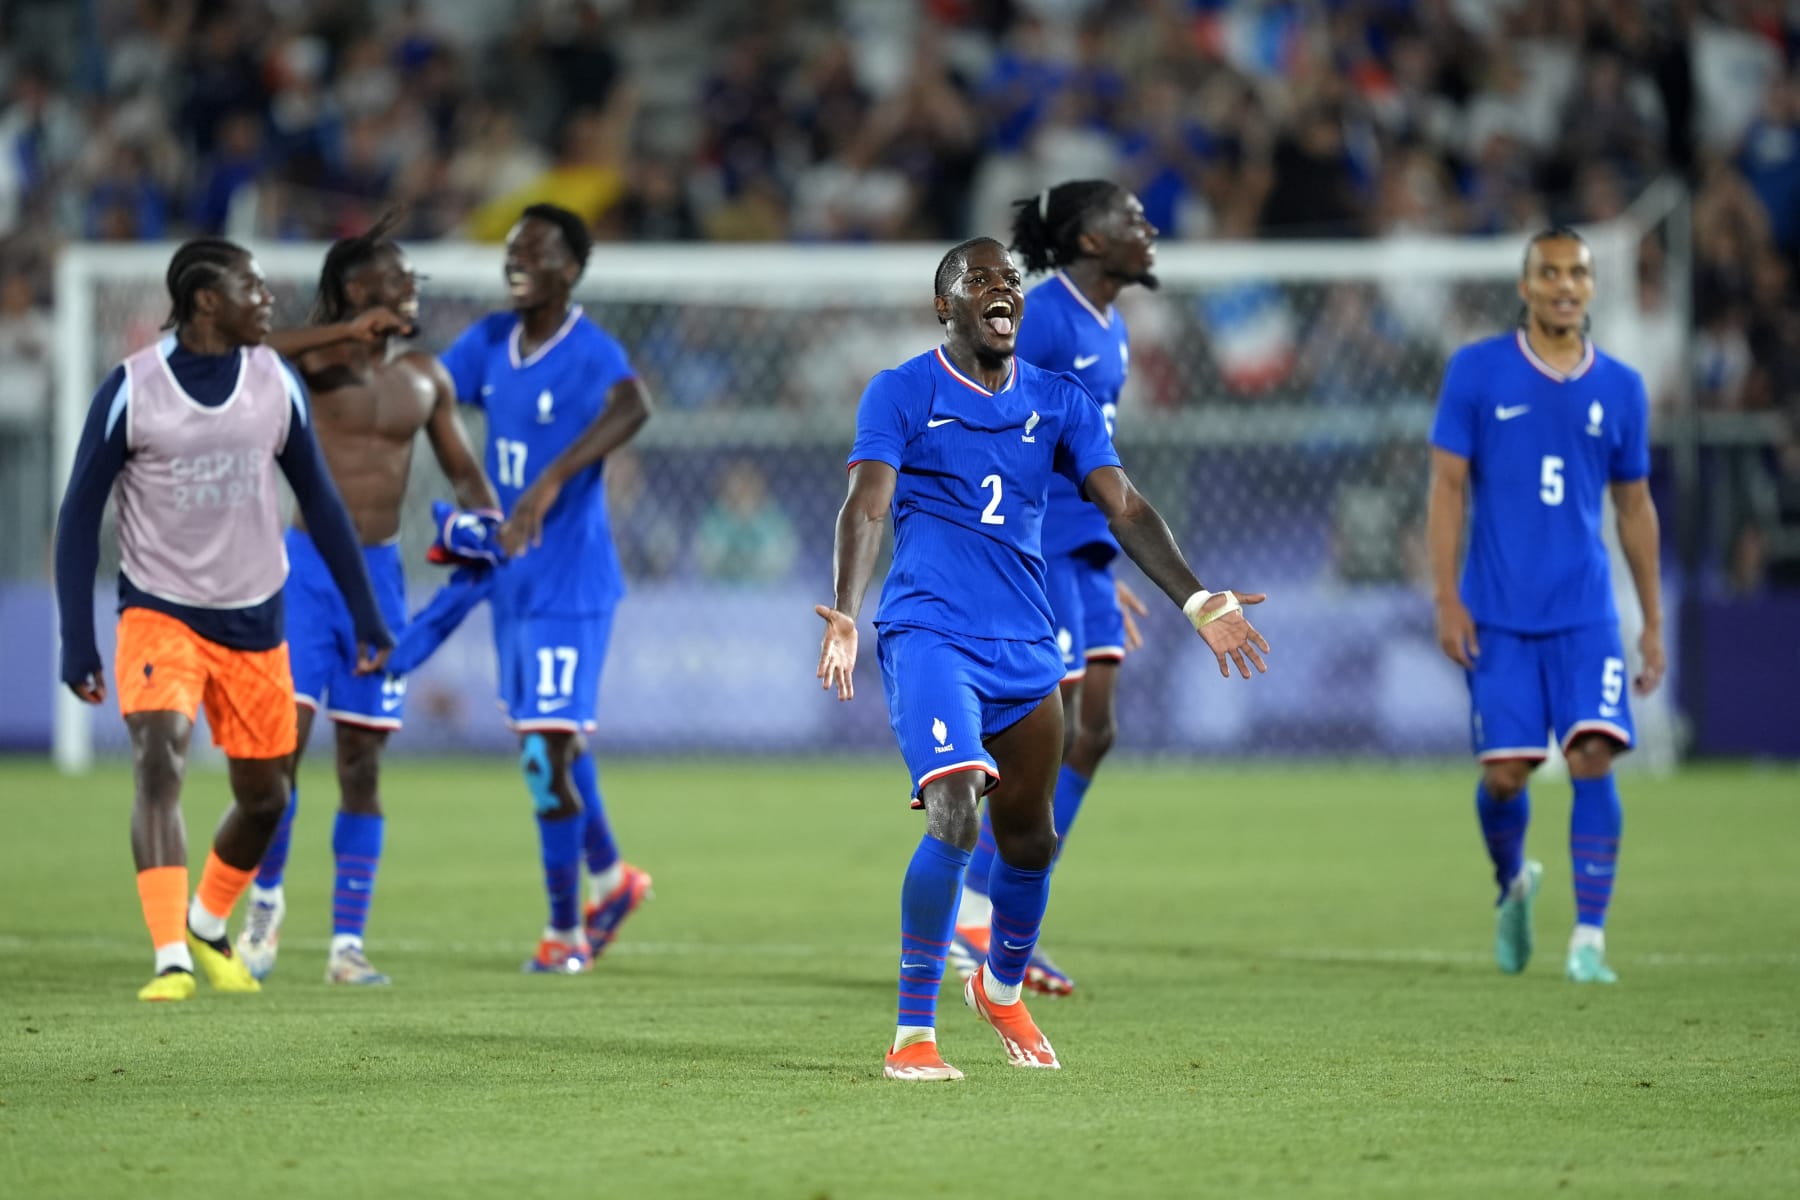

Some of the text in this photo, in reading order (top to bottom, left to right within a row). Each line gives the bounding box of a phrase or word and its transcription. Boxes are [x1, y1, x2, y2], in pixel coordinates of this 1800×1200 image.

[496, 437, 528, 490] 17
[1539, 454, 1565, 506] 5
[980, 474, 1005, 525] 2
[536, 646, 579, 697] 17
[1601, 656, 1624, 704] 5
[934, 743, 955, 754] FRANCE
